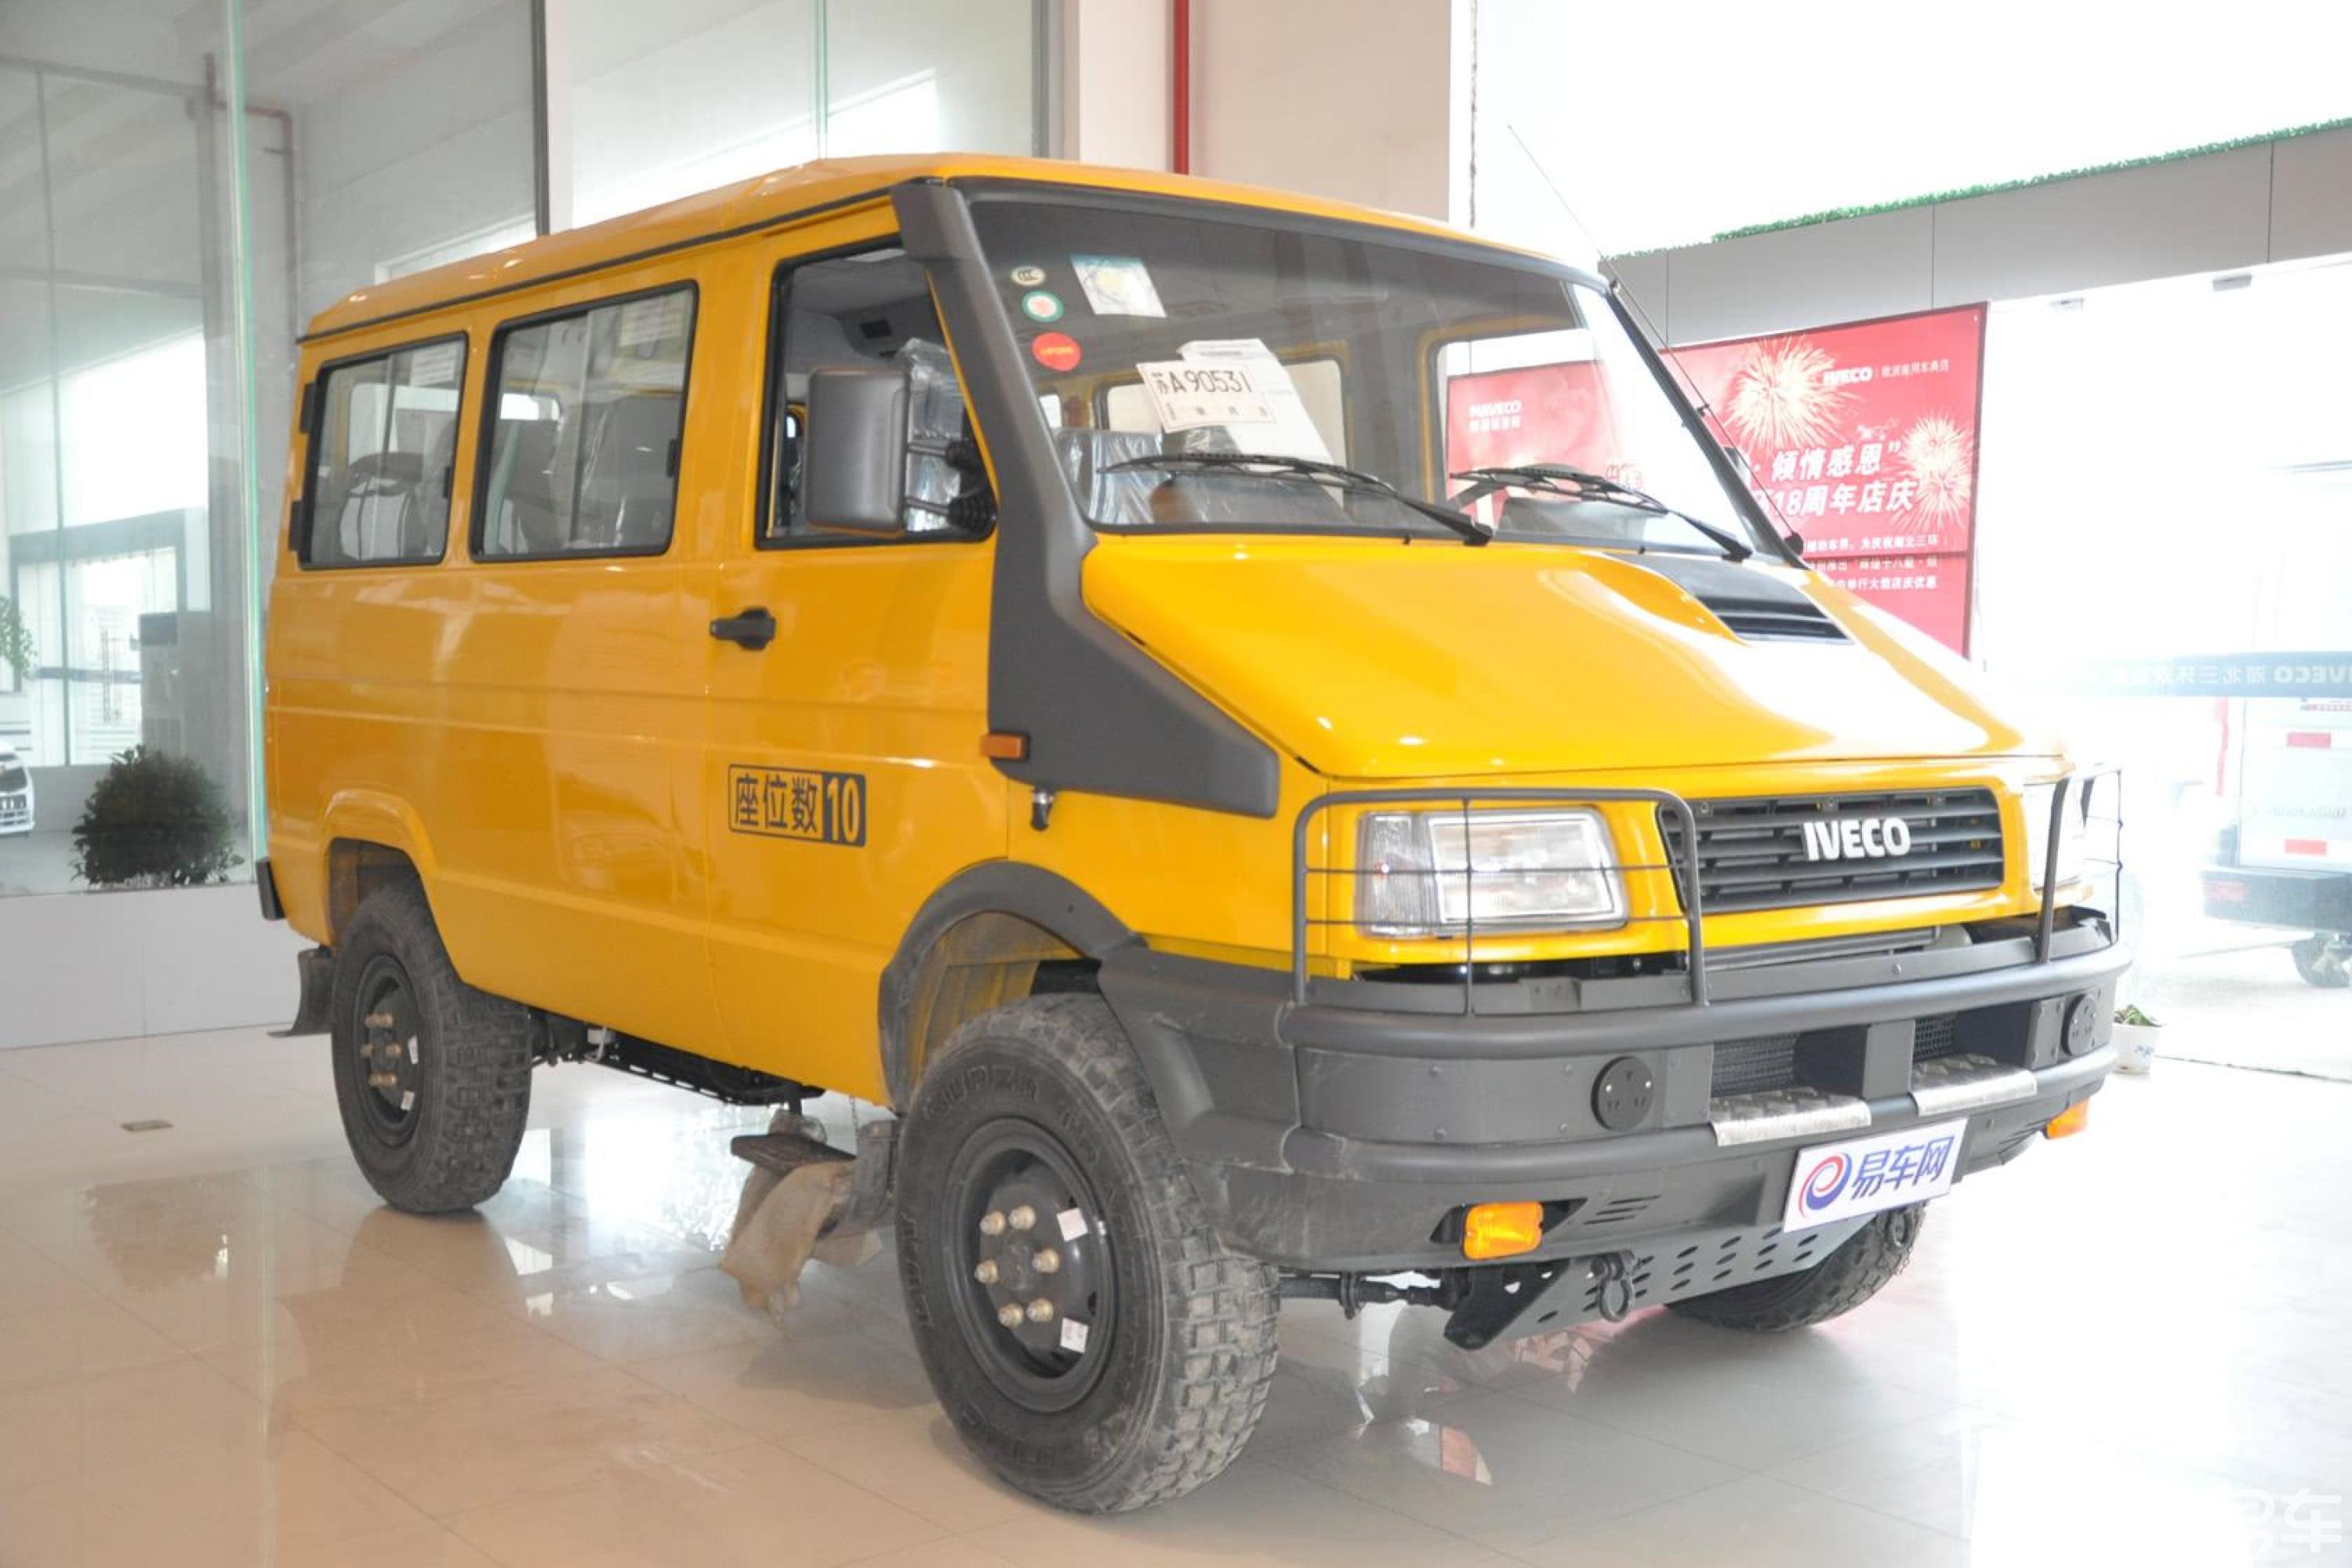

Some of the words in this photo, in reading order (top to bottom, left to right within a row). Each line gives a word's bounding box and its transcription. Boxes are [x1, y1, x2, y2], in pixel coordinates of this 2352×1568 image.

[1802, 817, 1911, 862] IVECO
[1851, 1136, 1955, 1200] 易车网
